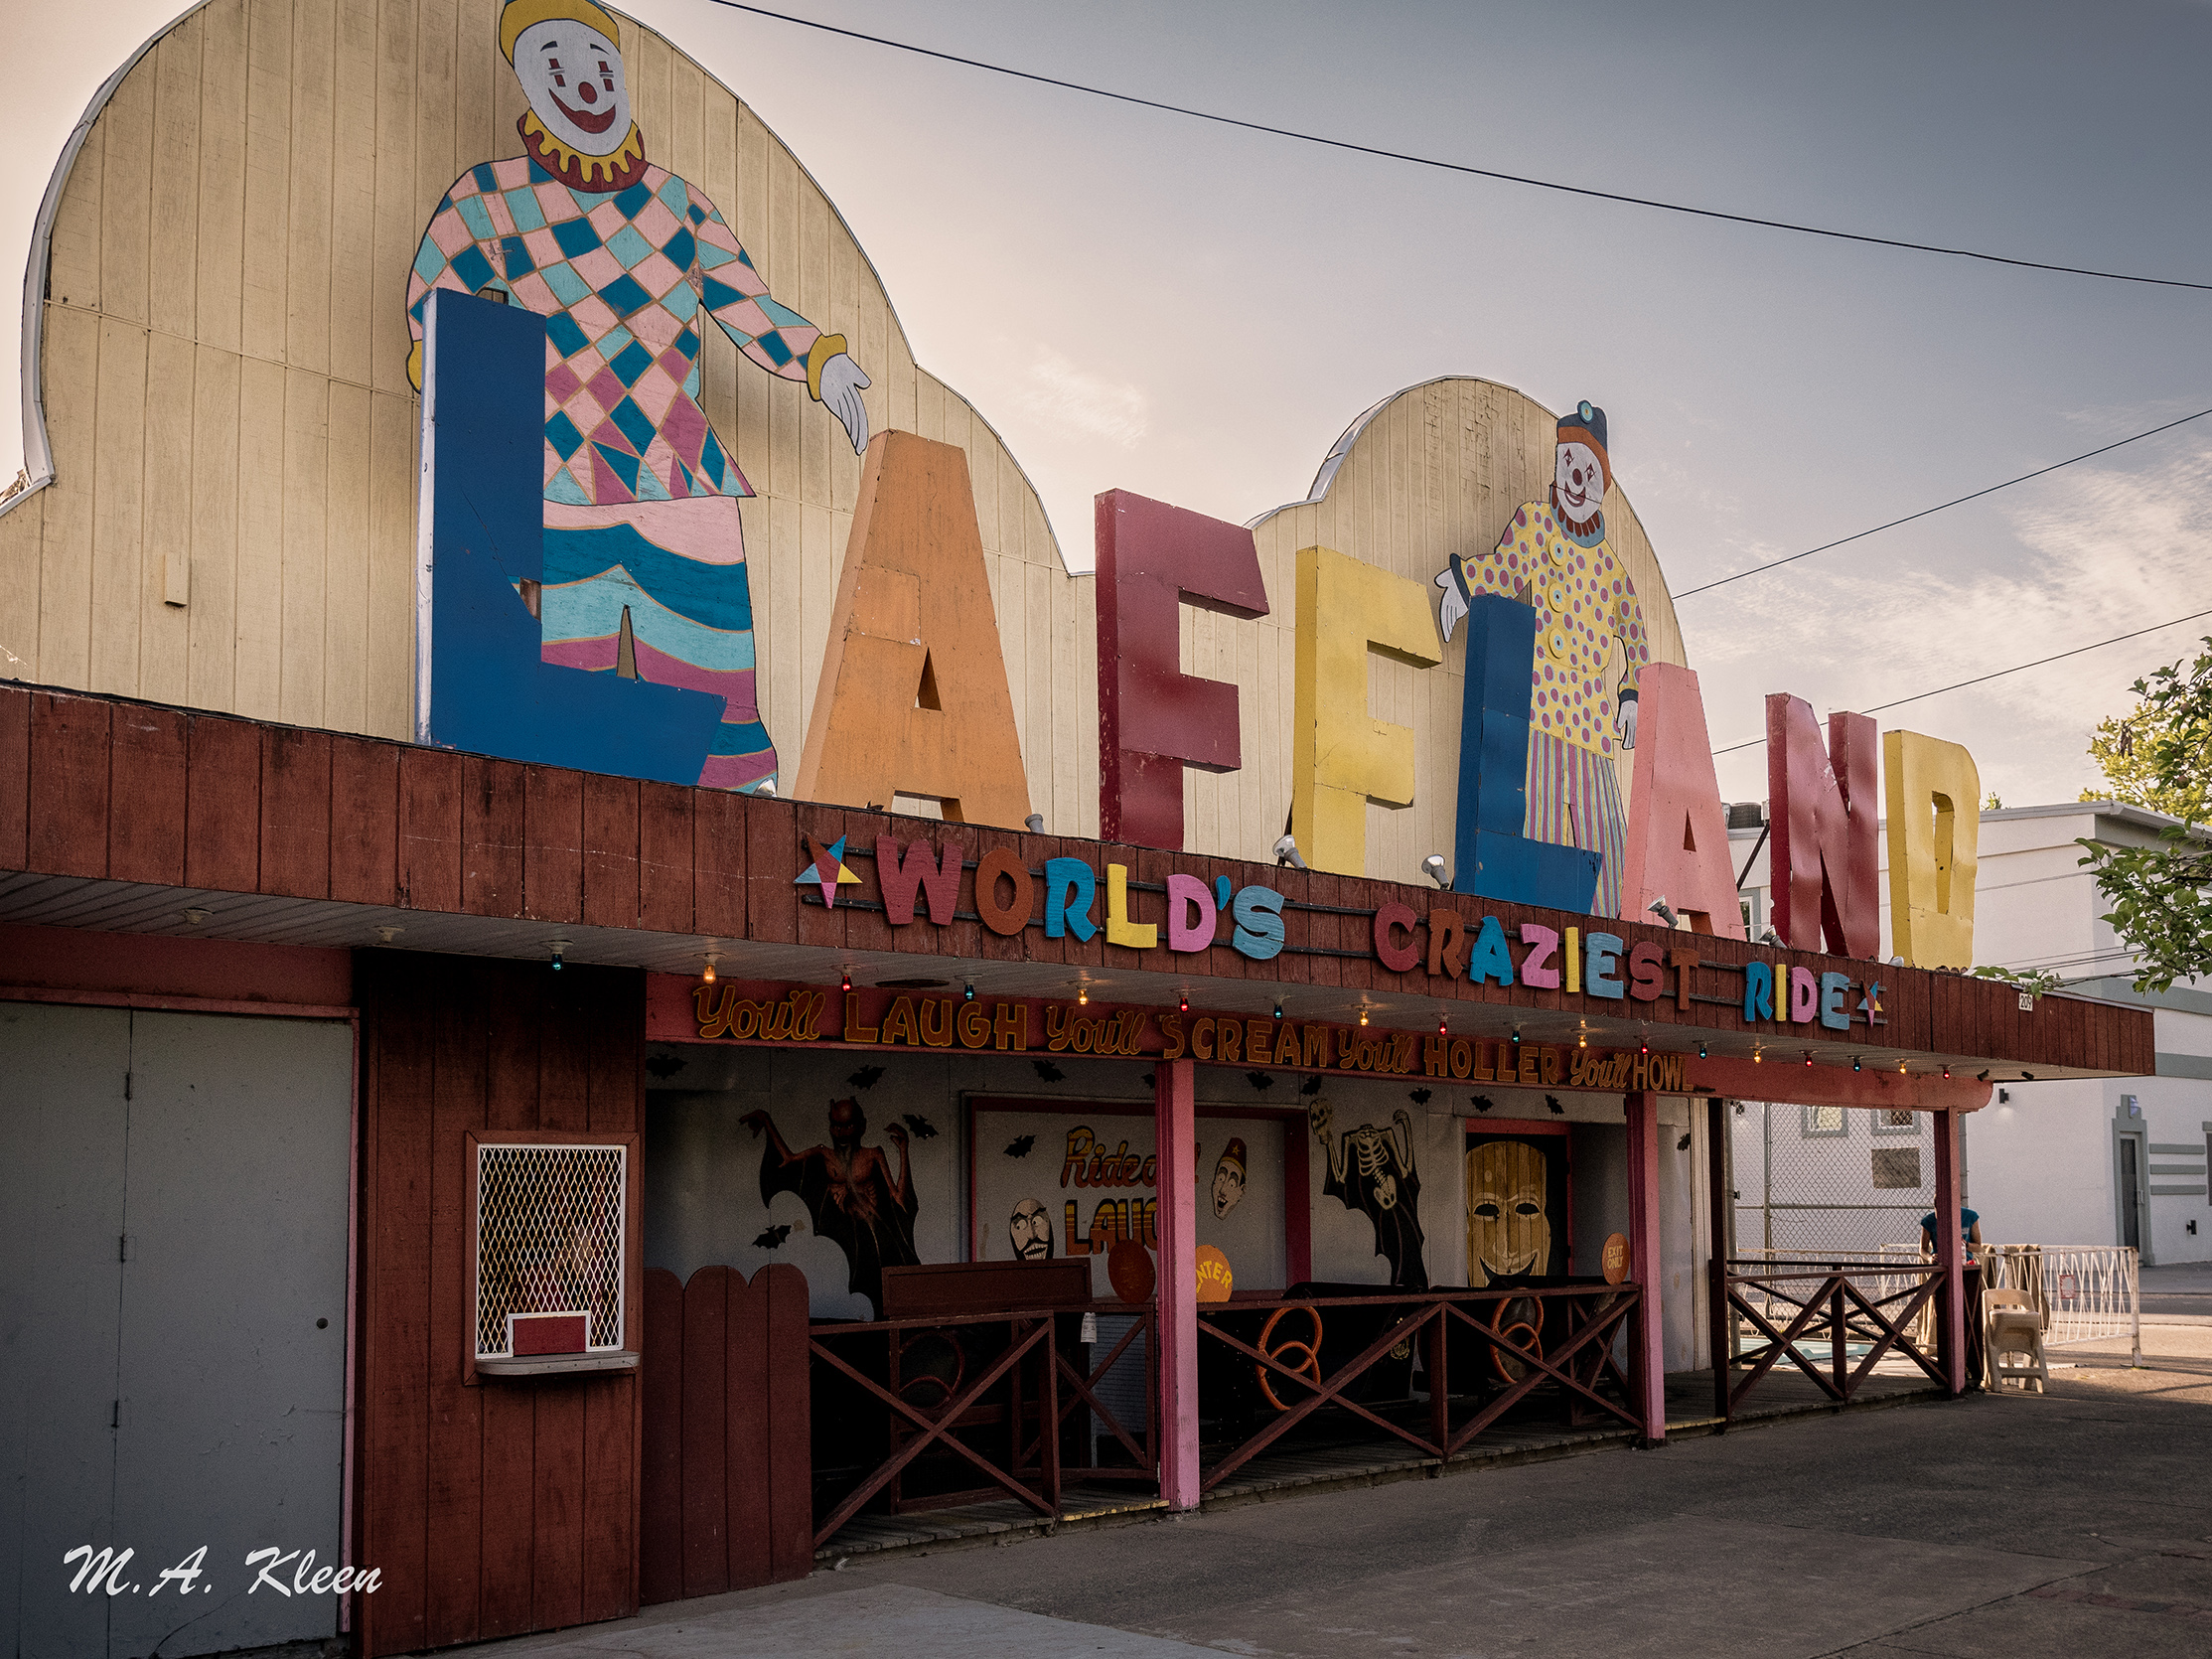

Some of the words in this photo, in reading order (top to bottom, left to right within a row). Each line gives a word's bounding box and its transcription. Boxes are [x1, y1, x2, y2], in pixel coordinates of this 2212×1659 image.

[414, 288, 1982, 973] LAFFLAND
[876, 834, 1285, 960] WORLD'S
[1374, 902, 1699, 1011] CRAZIEST
[1744, 961, 1850, 1030] RIDE
[693, 985, 826, 1040] You'll
[844, 993, 1027, 1051] LAUGH
[1046, 1004, 1145, 1056] You'll
[1161, 1014, 1329, 1068] SCREAM
[1337, 1028, 1413, 1074] You'll
[1424, 1036, 1559, 1086] HOLLER
[1570, 1049, 1632, 1089] You'll
[1632, 1053, 1695, 1091] HOWL
[1196, 1259, 1233, 1293] NTER
[1607, 1245, 1624, 1258] EXIT
[1607, 1256, 1624, 1270] ONLY
